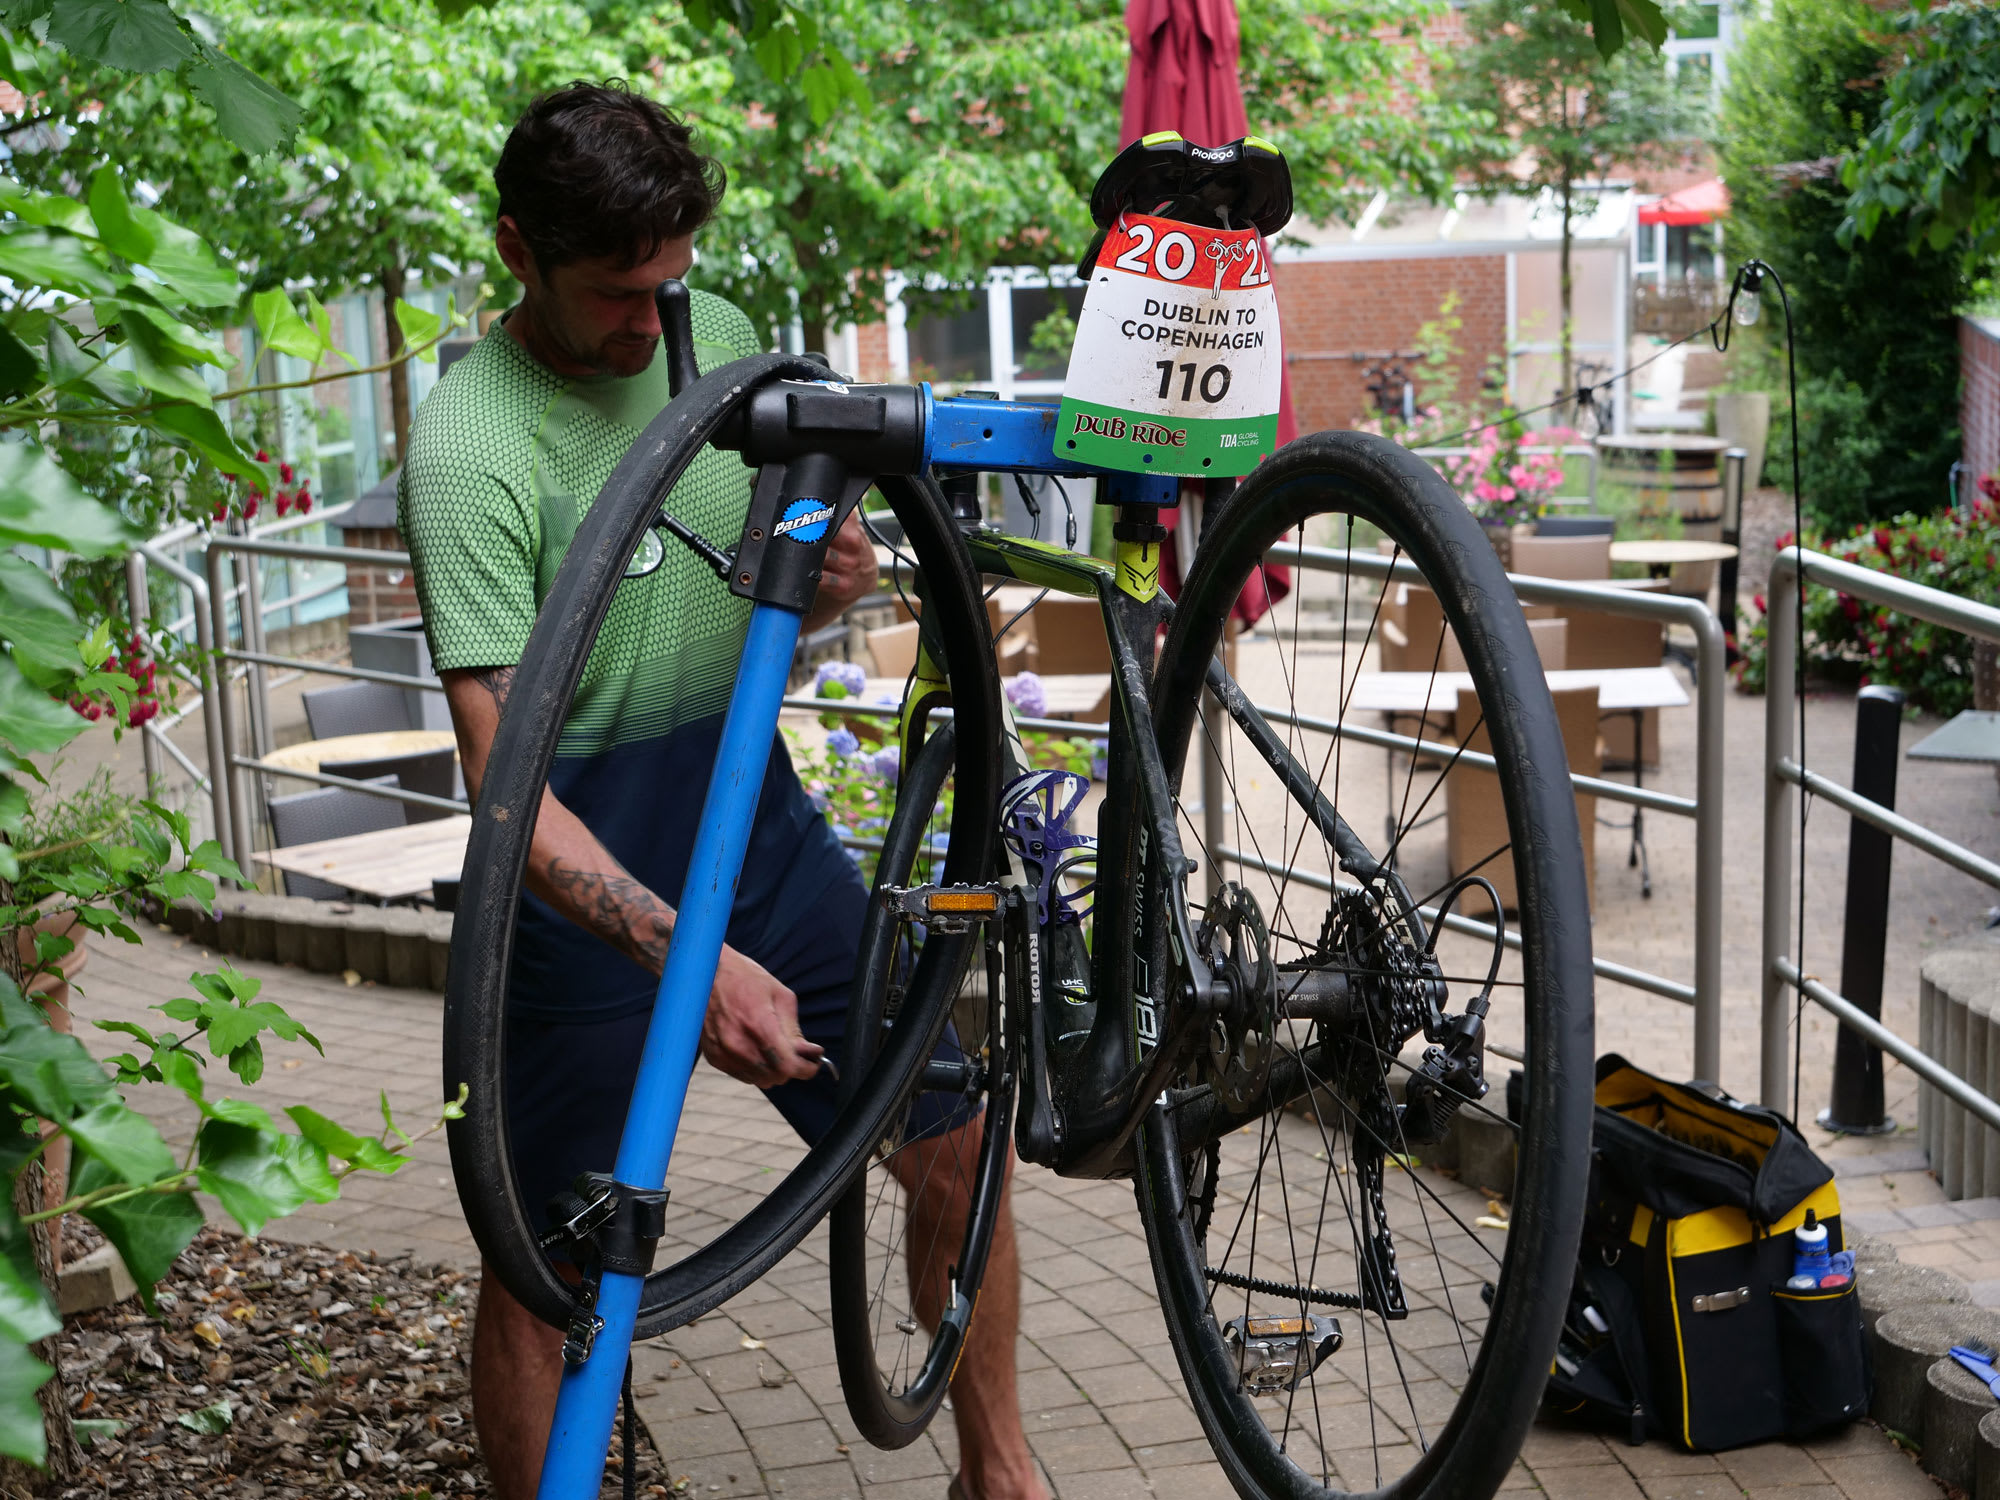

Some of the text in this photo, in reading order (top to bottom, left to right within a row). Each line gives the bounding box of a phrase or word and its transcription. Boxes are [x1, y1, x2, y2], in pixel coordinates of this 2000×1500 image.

[1115, 223, 1197, 281] 20
[1143, 298, 1256, 326] DUBLIN TO
[1121, 320, 1264, 350] COPENHAGEN
[1156, 360, 1231, 404] 110
[1220, 433, 1237, 448] TDA
[1237, 439, 1259, 447] CYCLING
[1238, 432, 1259, 440] GLOBAL
[1133, 825, 1149, 938] DT SWISS
[1300, 993, 1319, 1001] SWISS
